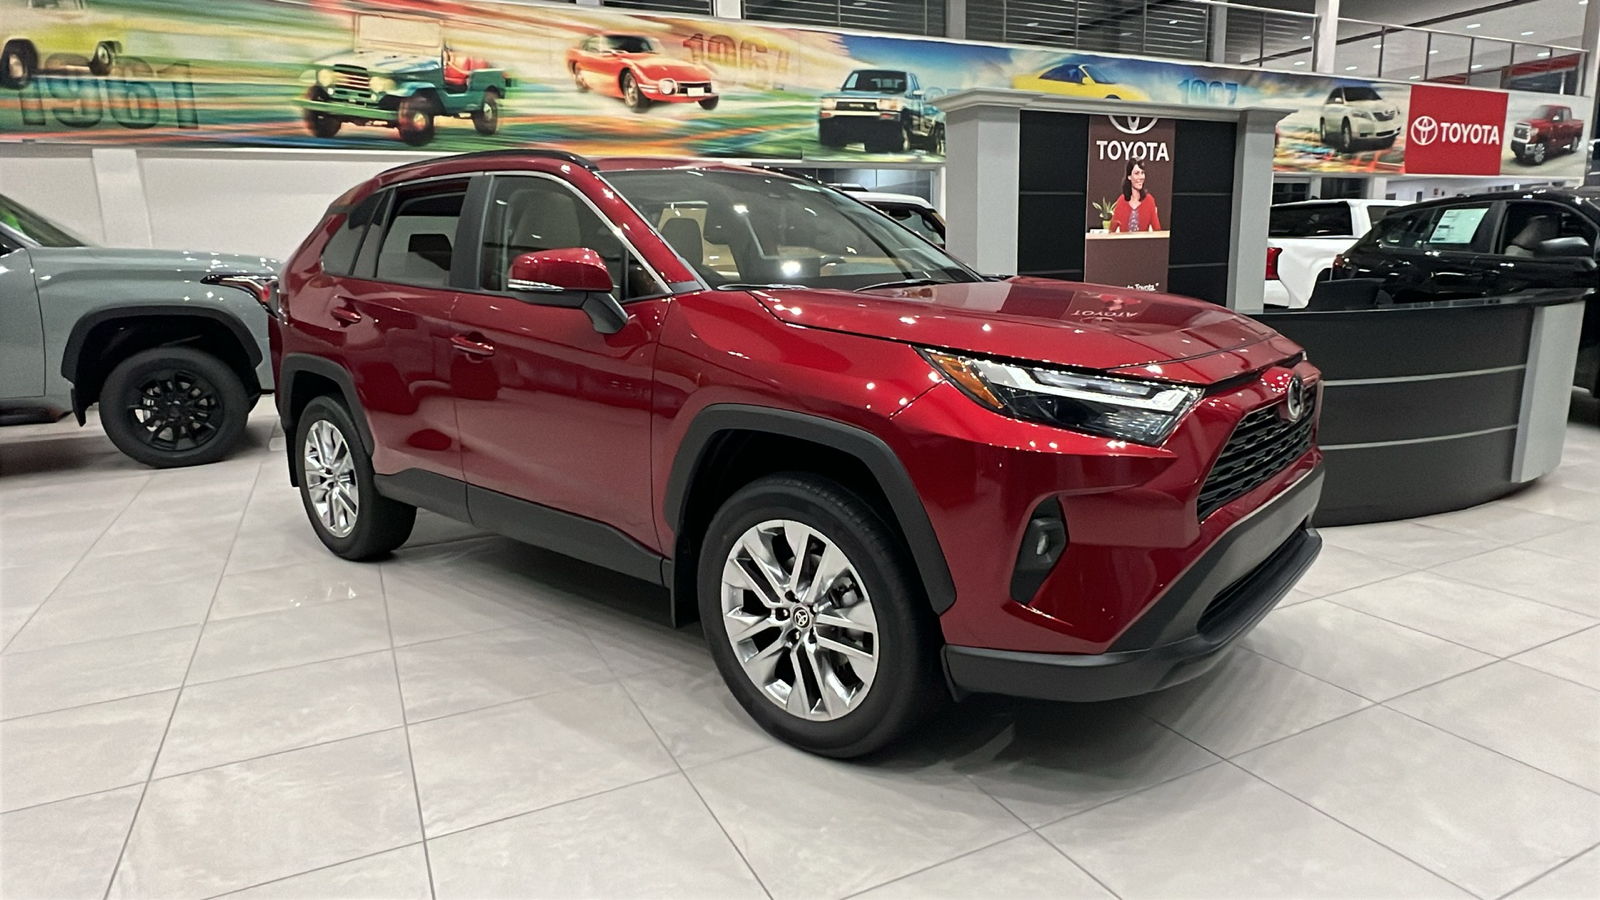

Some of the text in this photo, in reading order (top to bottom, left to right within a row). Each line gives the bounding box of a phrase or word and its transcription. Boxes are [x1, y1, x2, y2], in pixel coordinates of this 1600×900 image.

[19, 53, 199, 129] 1961
[1440, 122, 1500, 145] TOYOTA
[1096, 140, 1170, 162] TOYOTA
